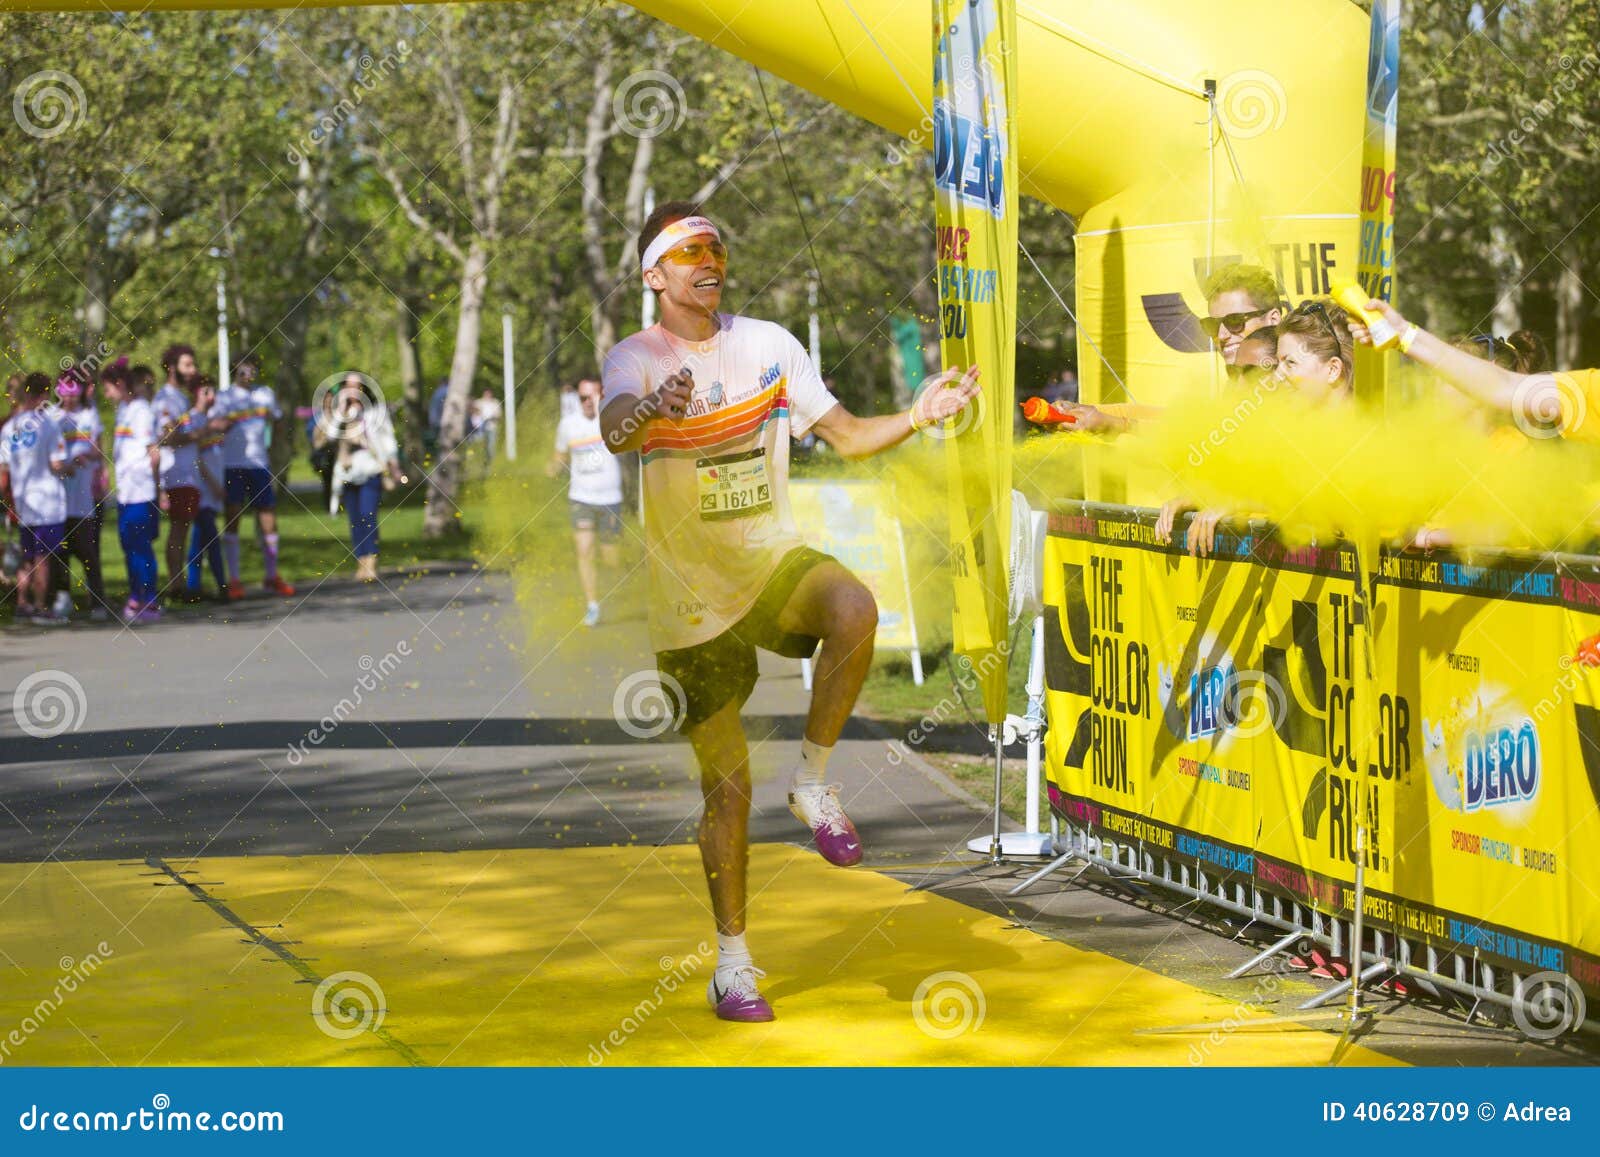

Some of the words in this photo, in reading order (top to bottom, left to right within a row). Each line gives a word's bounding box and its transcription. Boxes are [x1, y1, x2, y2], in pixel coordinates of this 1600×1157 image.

[722, 488, 754, 509] 1621
[1091, 555, 1123, 633] THE
[1091, 634, 1151, 720] COLOR
[1092, 712, 1128, 795] RUN
[1466, 722, 1538, 808] DERO
[1451, 829, 1480, 856] SPONSOR
[1362, 894, 1386, 921] APPIEST
[1405, 907, 1418, 930] THE
[1449, 919, 1463, 943] THE
